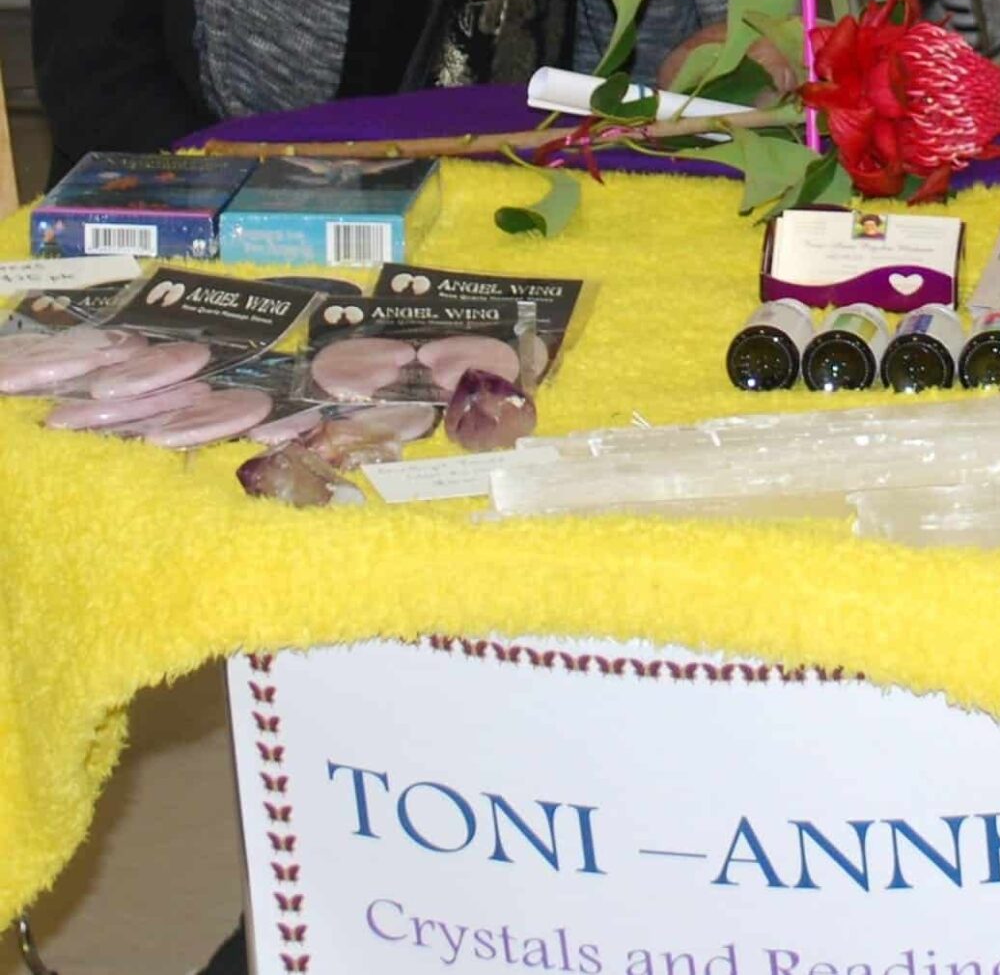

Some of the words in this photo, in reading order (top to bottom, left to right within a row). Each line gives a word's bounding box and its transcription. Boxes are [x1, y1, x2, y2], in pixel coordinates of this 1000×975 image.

[185, 286, 241, 309] ANGEL
[244, 294, 292, 317] WING
[437, 278, 503, 295] ANGEL
[510, 284, 563, 297] WING
[371, 306, 439, 320] ANGEL
[444, 307, 500, 321] WING
[327, 758, 608, 876] TONI
[365, 897, 603, 975] Crystals
[625, 942, 738, 975] and
